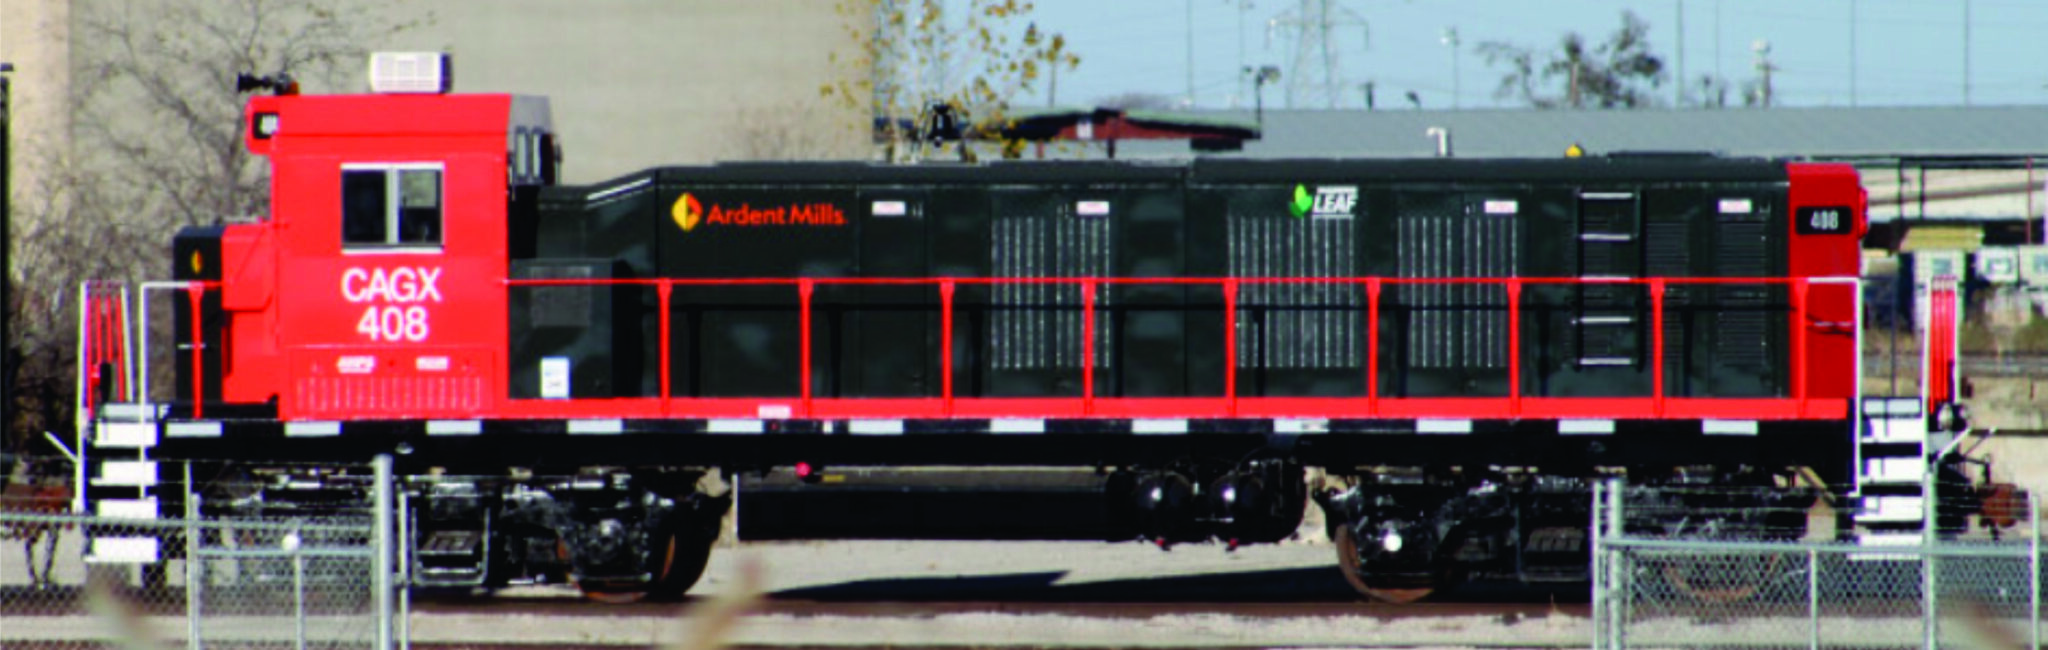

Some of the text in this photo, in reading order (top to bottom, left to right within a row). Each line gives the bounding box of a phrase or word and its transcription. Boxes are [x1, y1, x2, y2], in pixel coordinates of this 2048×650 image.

[706, 202, 786, 226] Ardent
[1312, 193, 1359, 214] LEAF
[341, 266, 443, 303] CAGX
[356, 305, 431, 342] 408
